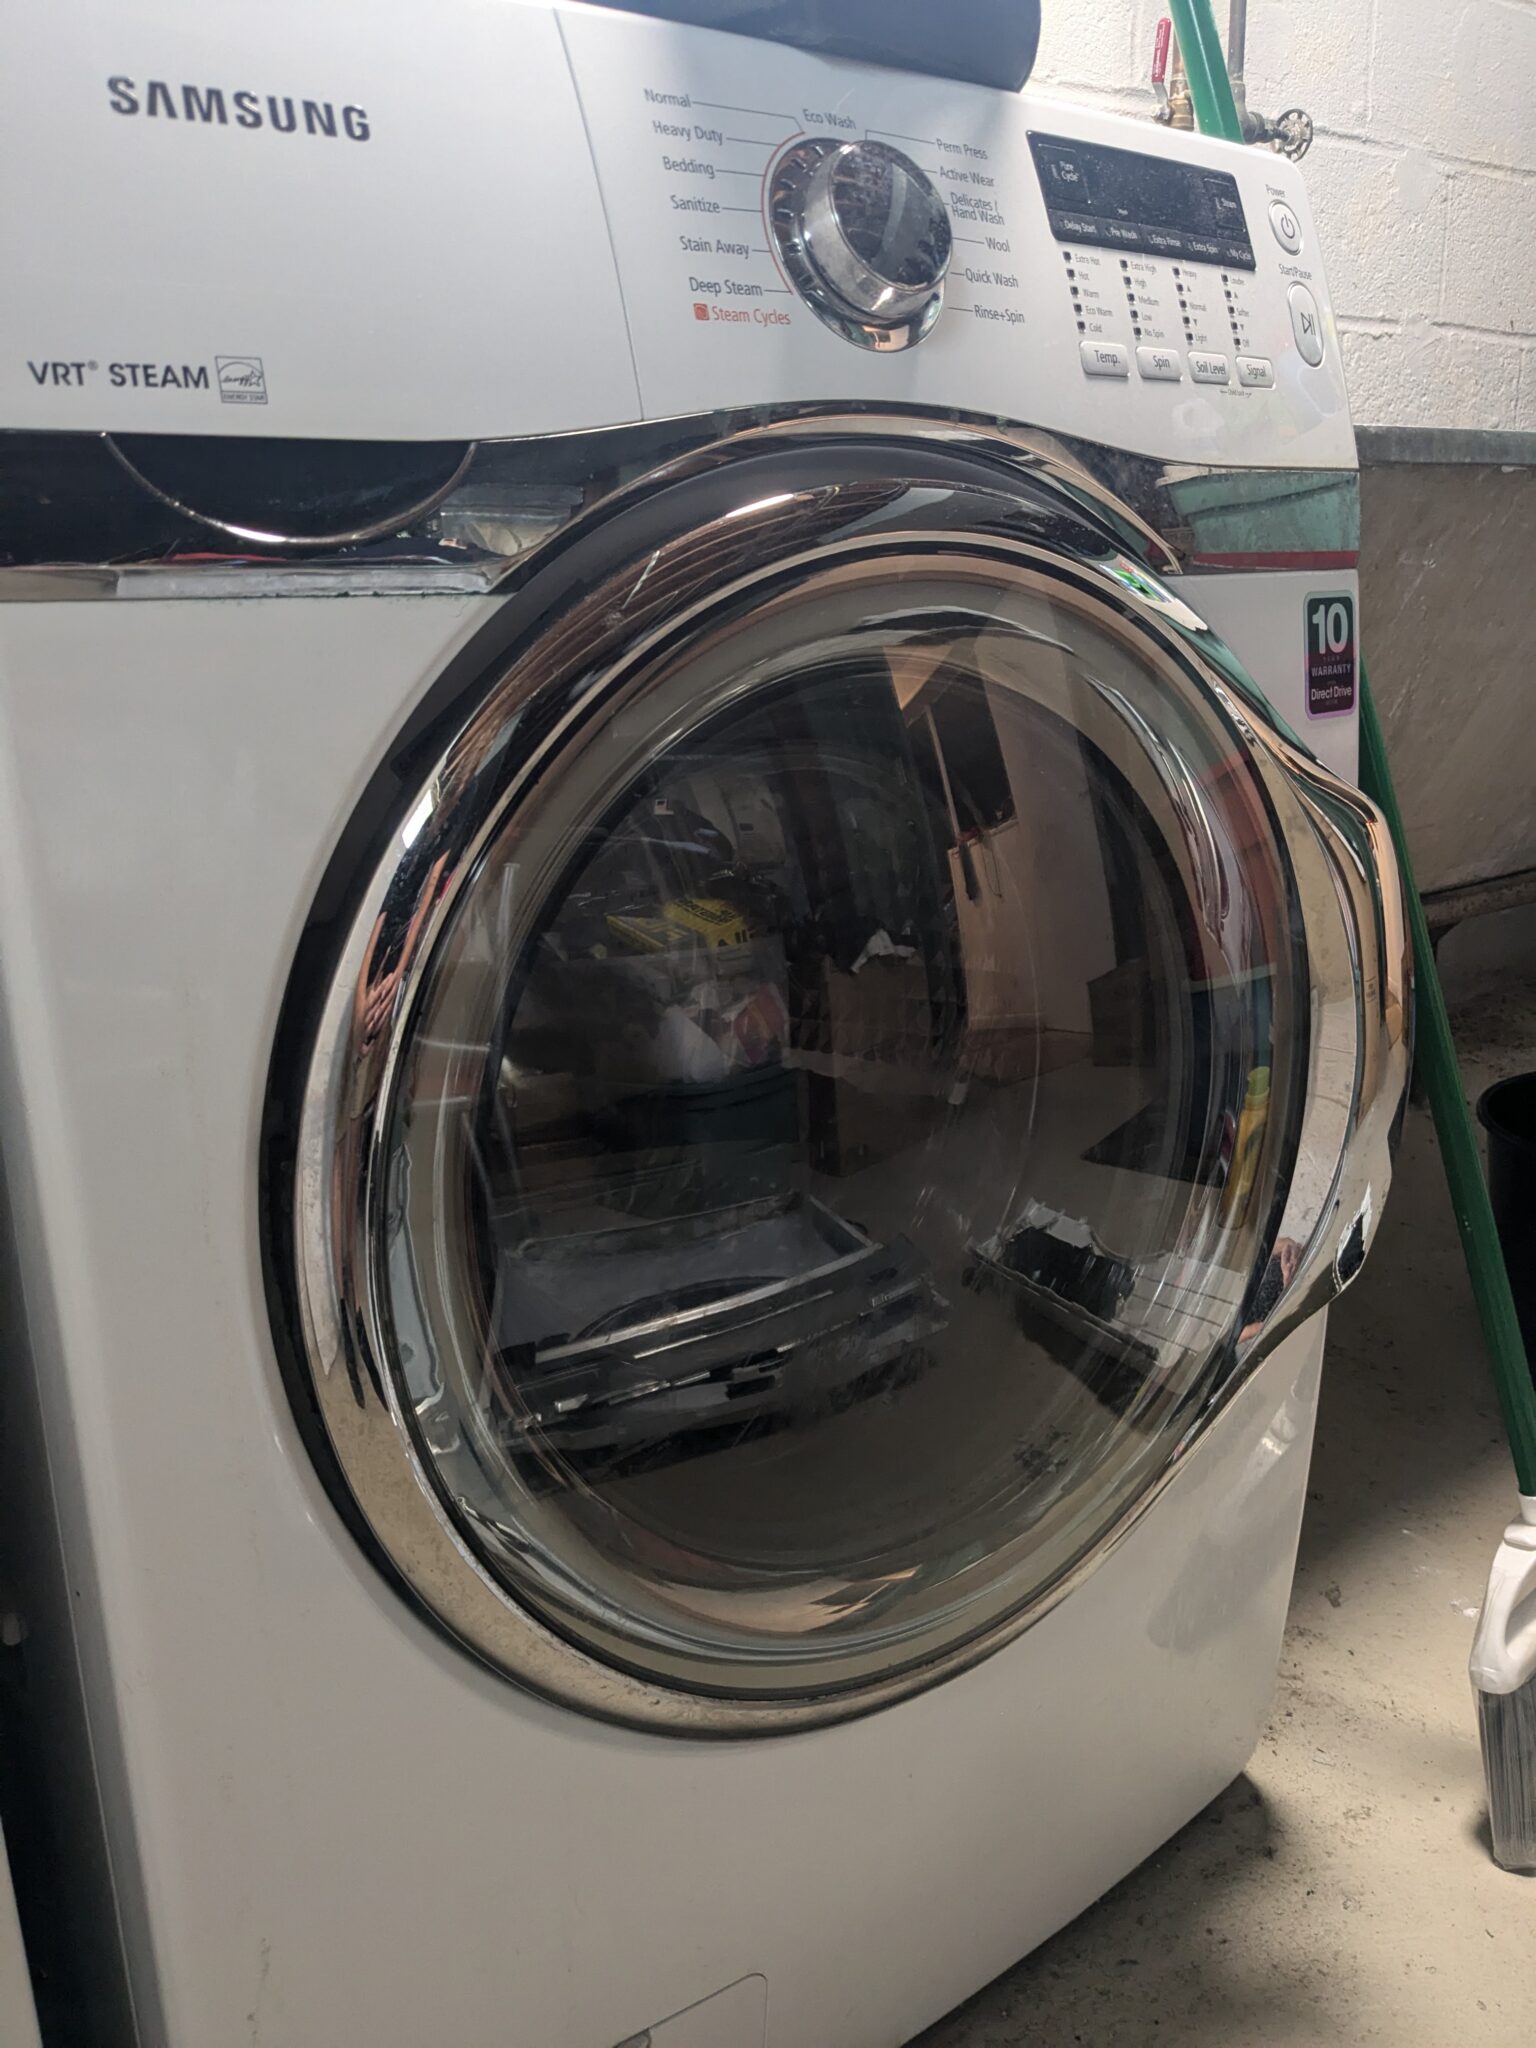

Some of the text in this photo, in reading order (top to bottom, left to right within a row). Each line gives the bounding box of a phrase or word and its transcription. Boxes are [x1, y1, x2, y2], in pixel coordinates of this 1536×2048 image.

[108, 75, 372, 141] SAMSUNG
[643, 88, 691, 108] Normal
[802, 109, 857, 130] Eco Wash
[652, 120, 723, 145] Heavy Duty
[936, 139, 988, 160] Perm Press
[662, 156, 716, 179] Bedding
[940, 166, 995, 187] Active Wear
[1265, 184, 1285, 198] Power
[670, 194, 720, 214] Sanitize
[950, 192, 993, 211] Delicates
[952, 206, 1005, 226] Hand Wash
[679, 236, 749, 259] Stain Away
[985, 236, 1011, 252] Wool
[965, 268, 1019, 288] Quick Wash
[1279, 263, 1312, 280] Start/Pause
[689, 276, 763, 297] Deep Steam
[712, 306, 791, 327] Steam Cycles
[974, 303, 1025, 324] Rinse+Spin
[1089, 322, 1102, 333] Cold
[1094, 350, 1120, 367] Temp.
[1153, 355, 1171, 371] Spin
[1196, 361, 1226, 376] Soil Level
[108, 363, 209, 389] STEAM
[1246, 364, 1267, 379] Signal
[1312, 603, 1348, 654] 10
[1311, 664, 1351, 677] WARRANTY
[1311, 684, 1352, 700] Direct Drive
